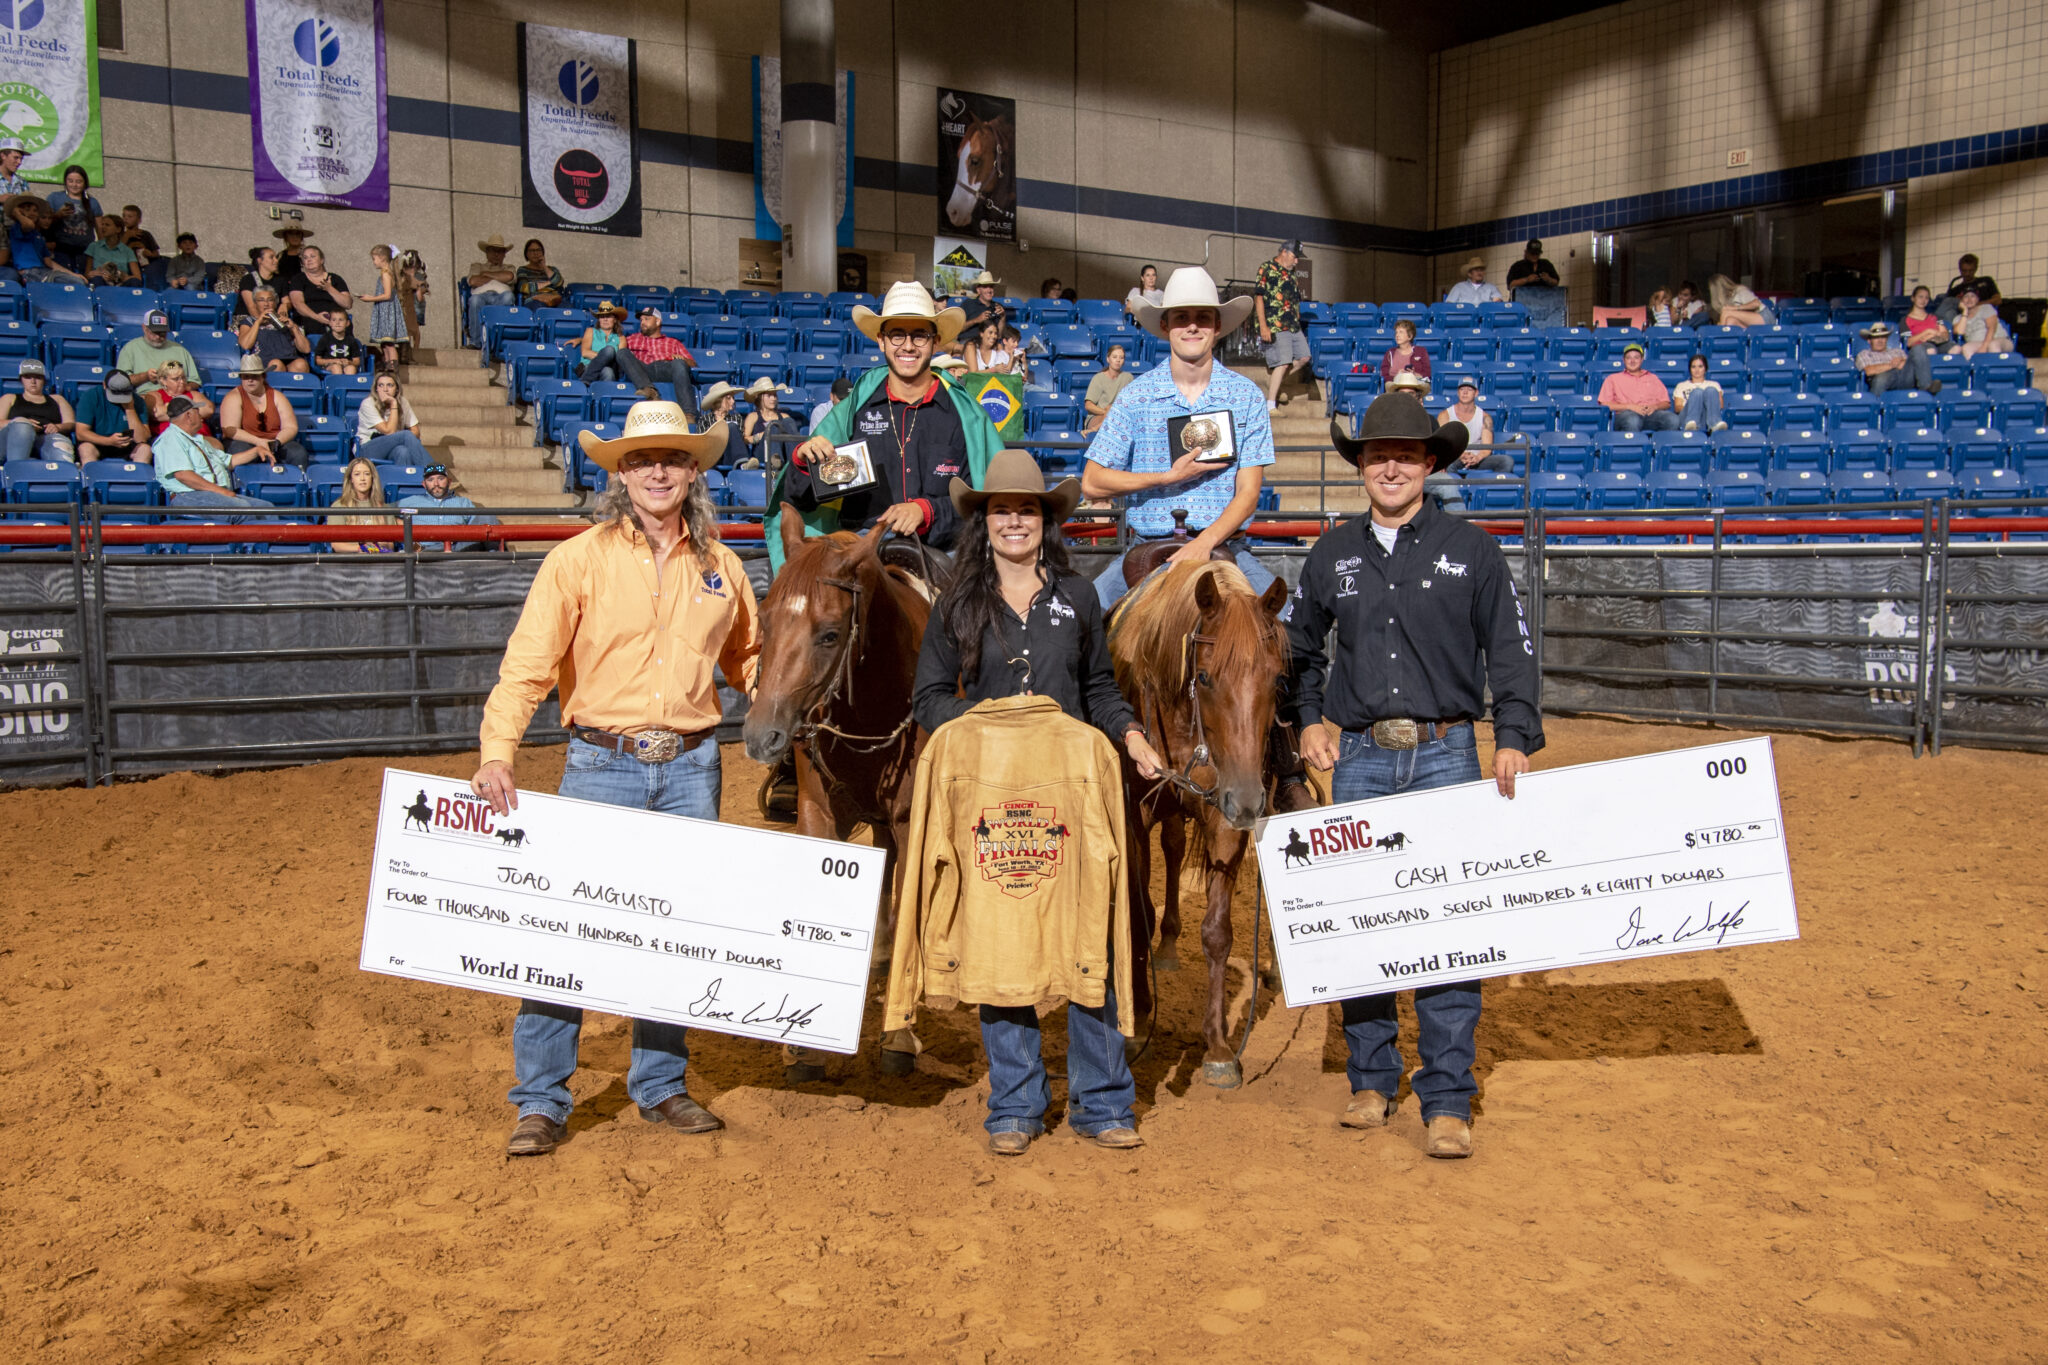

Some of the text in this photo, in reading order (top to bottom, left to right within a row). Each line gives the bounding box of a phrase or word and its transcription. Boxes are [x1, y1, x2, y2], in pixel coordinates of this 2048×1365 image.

[18, 34, 68, 52] Feeds
[3, 56, 45, 68] Nutrition
[276, 66, 359, 87] Total Feeds
[0, 84, 45, 106] OTAL
[543, 103, 617, 123] Total Feeds
[1731, 151, 1746, 165] EXIT
[572, 176, 591, 187] TOTAL
[11, 628, 64, 639] CINCH
[2, 736, 28, 744] NATIONAL
[1706, 756, 1747, 778] 000
[1004, 802, 1034, 810] CINCH
[434, 797, 496, 835] RSNC
[988, 817, 1049, 830] WORLD
[1323, 815, 1353, 825] CINCH
[1006, 830, 1034, 839] XVI
[1309, 820, 1373, 856] RSNC
[978, 840, 1059, 864] FINALS
[389, 859, 401, 868] Pay
[821, 857, 860, 879] 000
[1395, 850, 1552, 889] CASH FOWLER
[389, 866, 429, 879] The Order Of
[497, 866, 672, 916] JOAO AUGUSTO
[1282, 896, 1304, 908] Pay To
[1283, 900, 1324, 913] The Order Of
[1288, 919, 1340, 940] FOUR
[1348, 907, 1430, 931] THOUSAND
[1443, 895, 1492, 917] SEVEN
[1502, 887, 1575, 908] HUNDRED
[1596, 874, 1653, 894] EIGHTY
[1662, 867, 1725, 885] DOLLARS
[387, 888, 427, 906] FOUR
[436, 898, 510, 923] THOUSAND
[519, 914, 568, 933] SEVEN
[578, 923, 643, 947] HUNDRED
[664, 941, 717, 960] EIGHTY
[726, 950, 783, 970] DOLLARS
[389, 956, 405, 966] For
[1378, 946, 1507, 979] World Finals
[460, 954, 584, 992] World Finals
[1312, 985, 1328, 994] For
